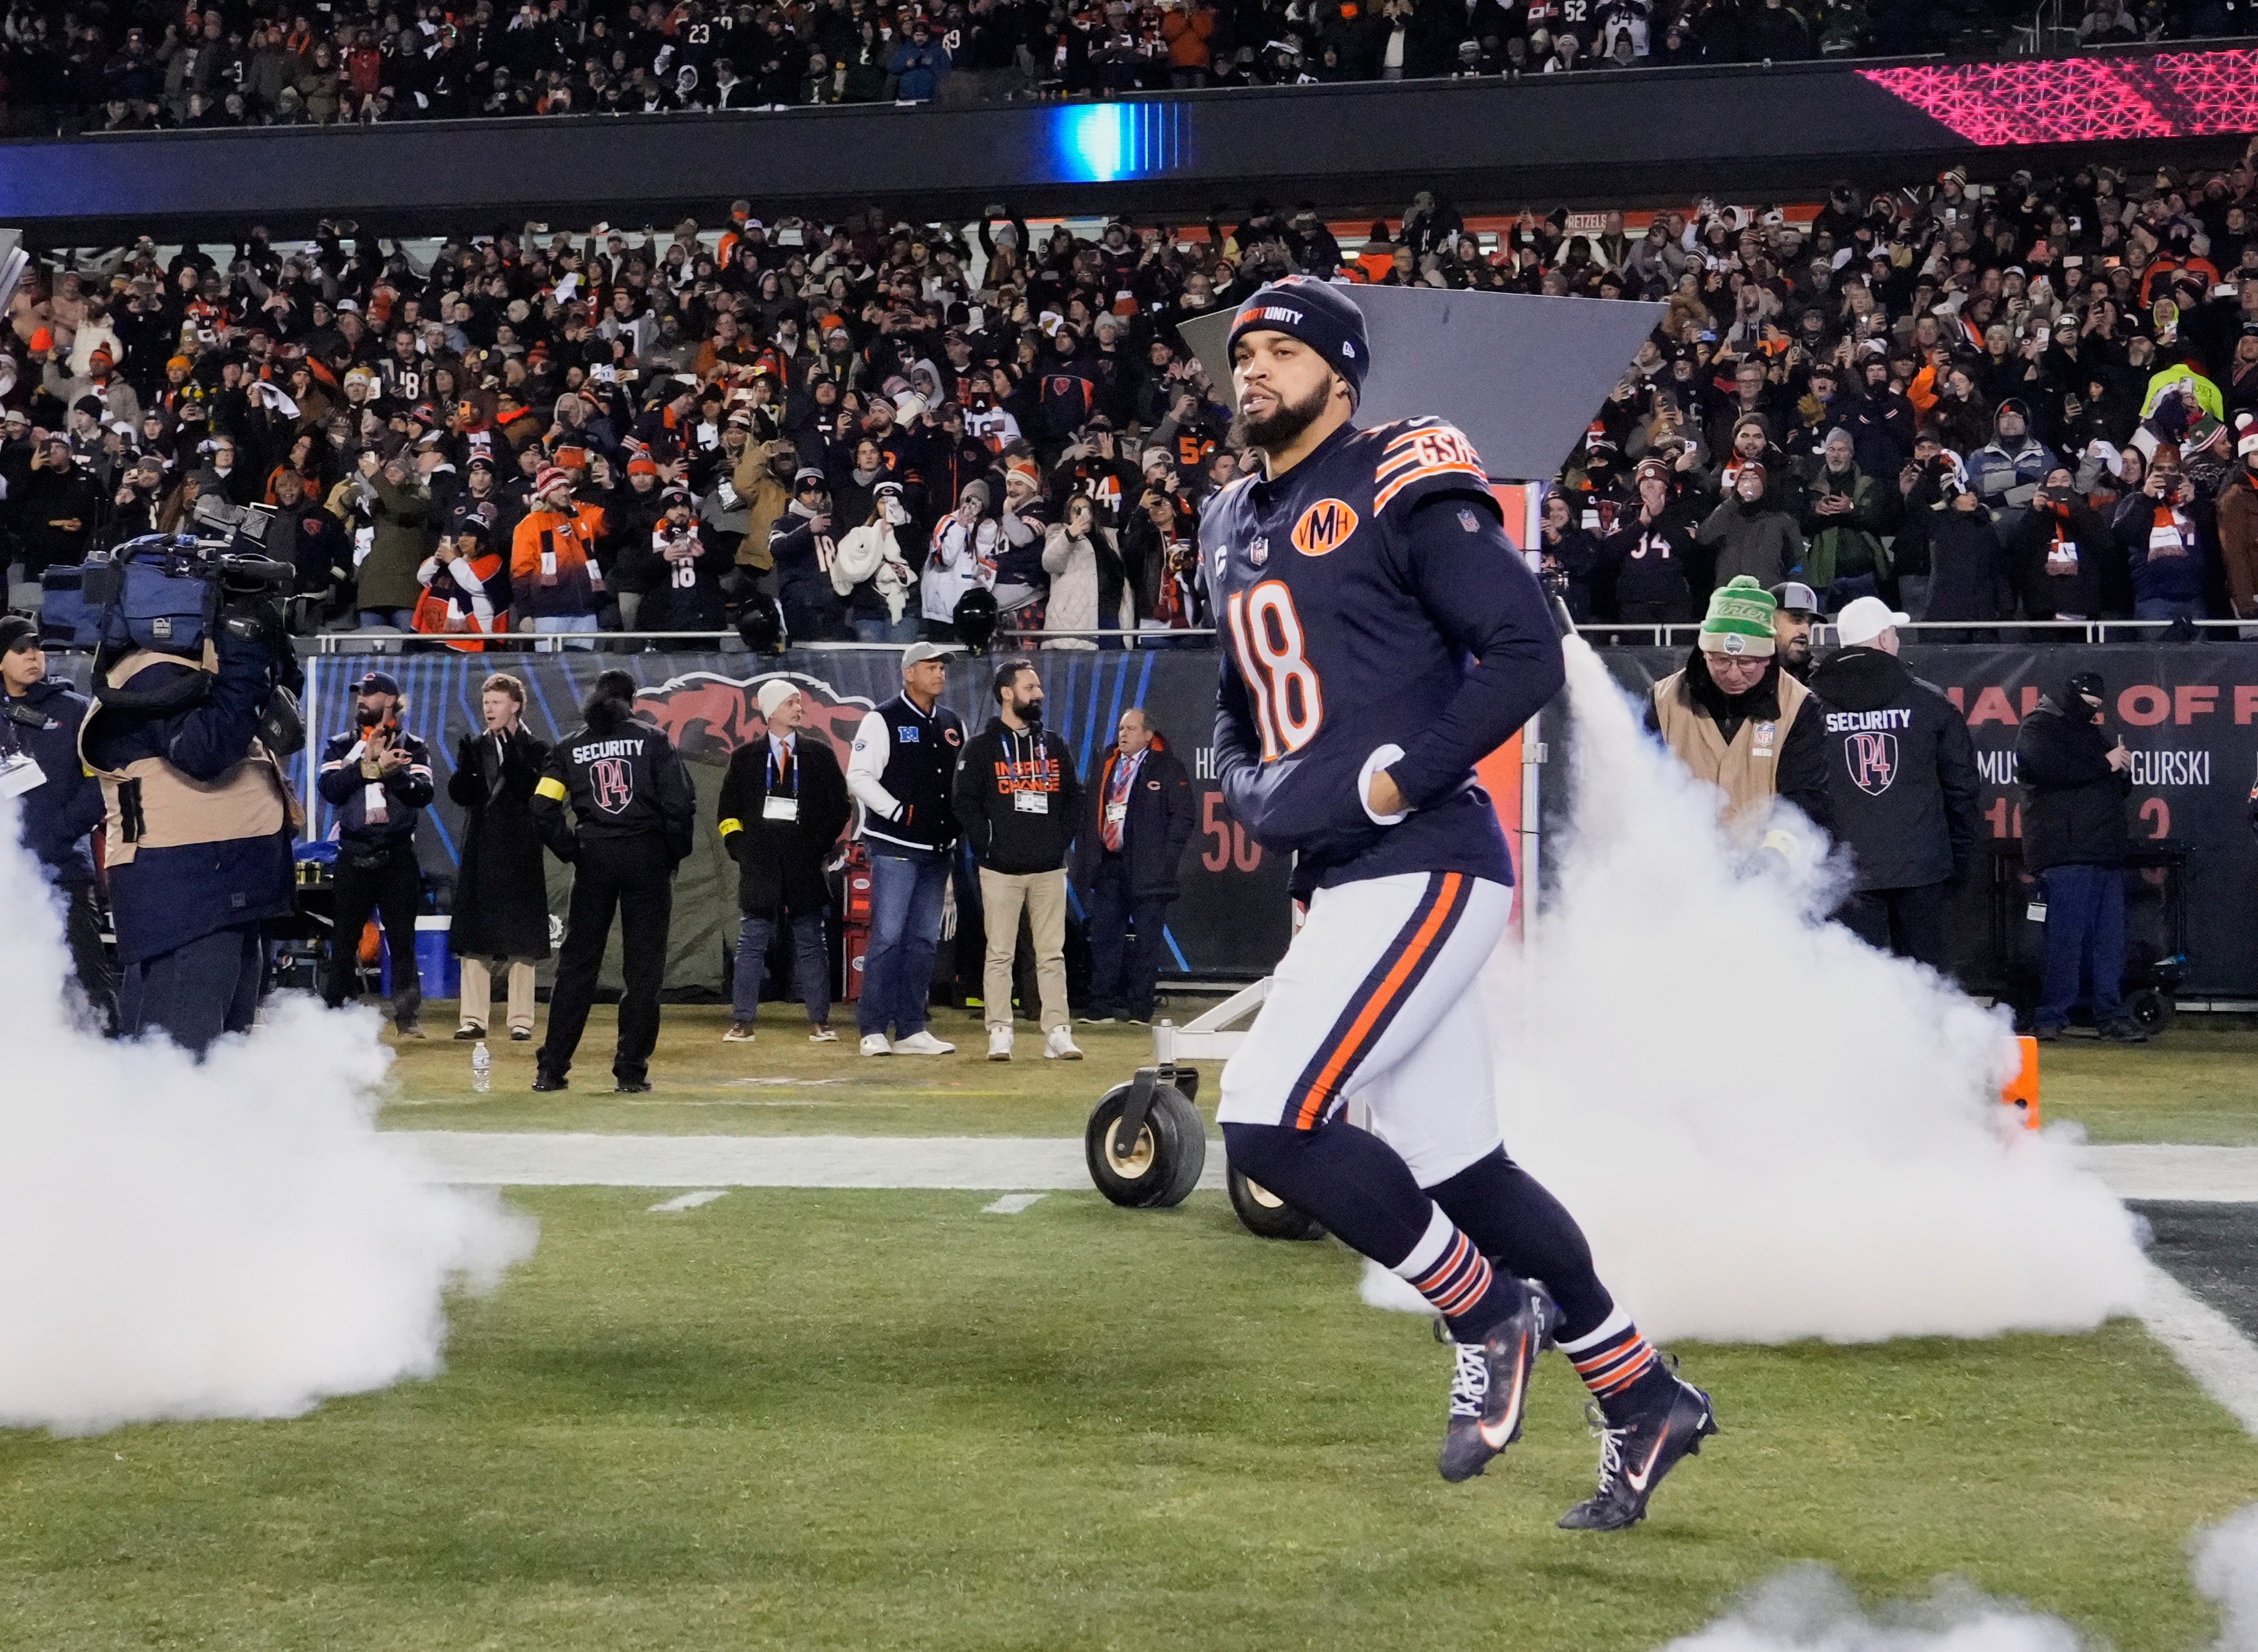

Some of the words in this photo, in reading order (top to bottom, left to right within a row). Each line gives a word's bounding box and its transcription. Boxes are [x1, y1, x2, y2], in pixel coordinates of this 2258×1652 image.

[1564, 0, 1587, 21] 52
[689, 24, 709, 44] 23
[400, 371, 420, 401] 18
[1229, 579, 1324, 762] 18
[2118, 685, 2219, 726] OF
[1826, 709, 1911, 733] SECURITY
[573, 739, 644, 765] SECURITY
[1856, 735, 1890, 786] P4
[994, 758, 1060, 778] INSPIRE
[2130, 750, 2210, 785] GURSKI
[598, 760, 629, 806] P4
